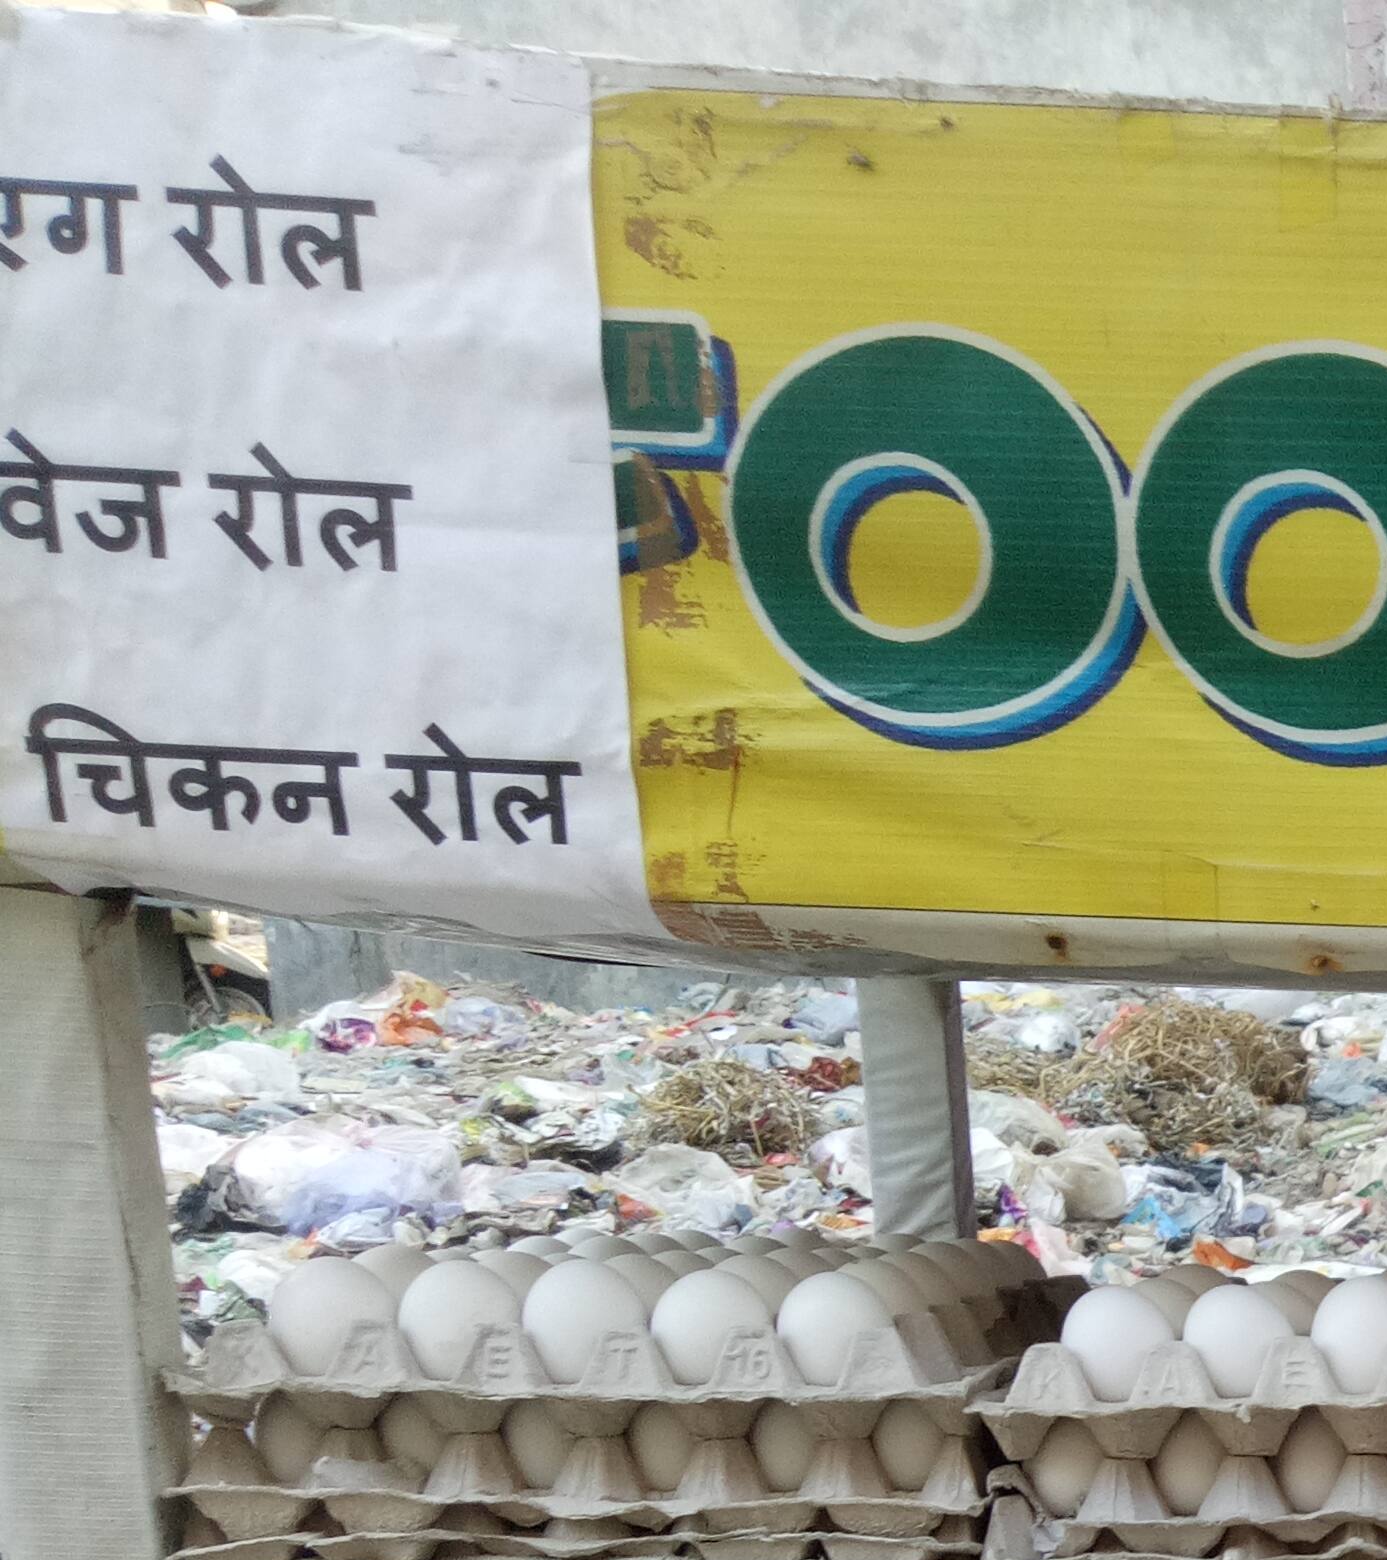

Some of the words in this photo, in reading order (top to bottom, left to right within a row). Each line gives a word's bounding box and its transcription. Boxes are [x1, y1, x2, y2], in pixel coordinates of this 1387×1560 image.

[165, 154, 376, 292] रोल
[0, 428, 181, 559] वेज
[207, 442, 413, 572] रोल
[24, 702, 359, 836] चिकन
[384, 722, 583, 846] रोल
